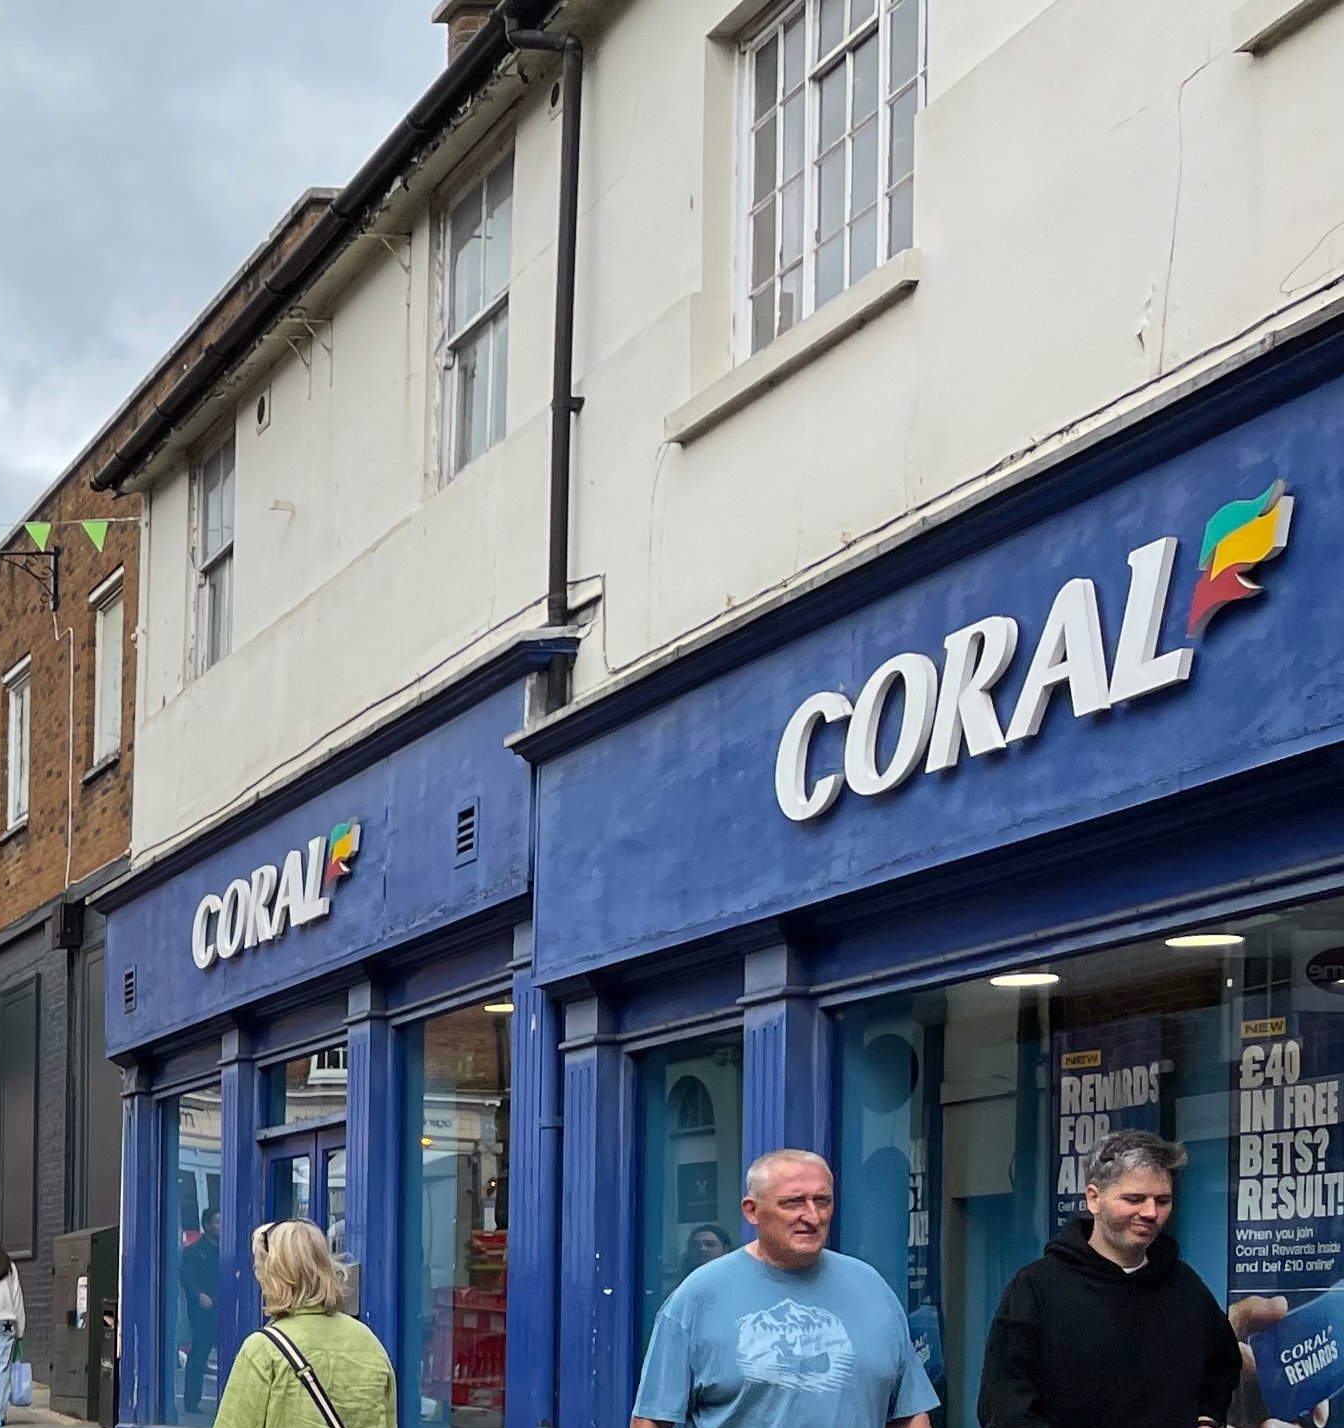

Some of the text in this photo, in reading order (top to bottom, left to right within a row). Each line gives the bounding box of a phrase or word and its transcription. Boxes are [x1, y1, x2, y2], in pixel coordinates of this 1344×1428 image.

[775, 537, 1194, 821] CORAL
[192, 836, 330, 969] CORAL
[1244, 1021, 1284, 1035] NEW
[1060, 1061, 1160, 1116] REWARDS
[1239, 1040, 1301, 1089] £40
[1240, 1080, 1340, 1133] IN FREE
[1239, 1127, 1330, 1177] BETS?
[1237, 1171, 1344, 1221] RESULT!
[1235, 1226, 1314, 1242] When you join
[1235, 1244, 1269, 1257] Coral
[1272, 1242, 1315, 1256] Rewards
[1235, 1260, 1259, 1273] and
[1263, 1260, 1281, 1273] bet
[1284, 1259, 1304, 1272] £10
[1280, 1329, 1329, 1364] CORAL
[1284, 1340, 1338, 1386] REWARDS
